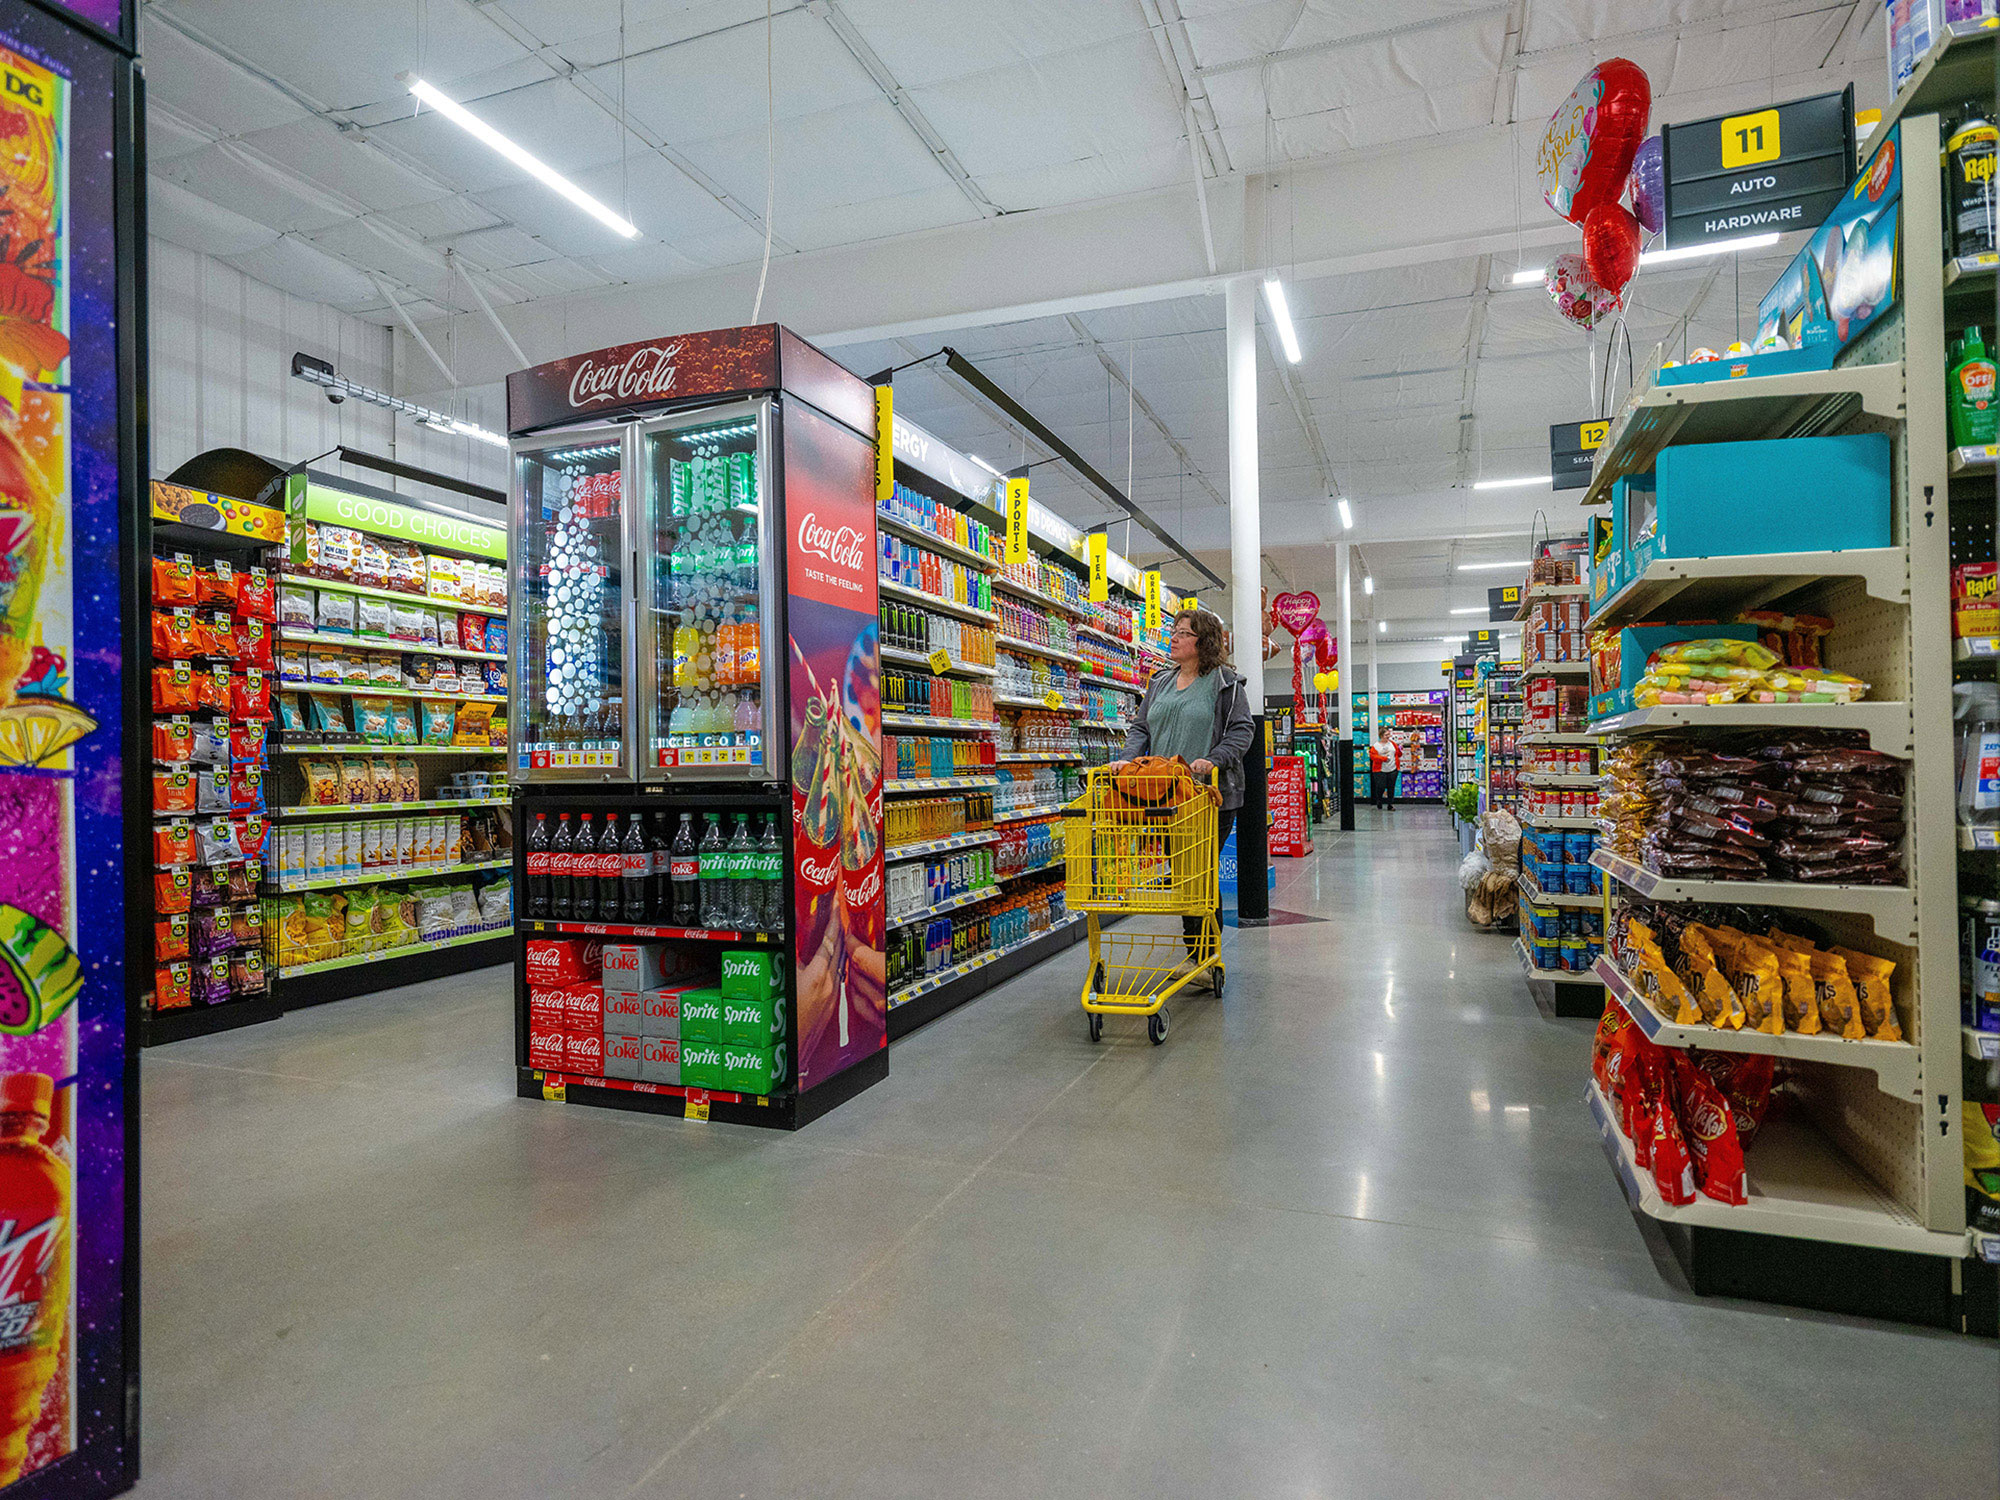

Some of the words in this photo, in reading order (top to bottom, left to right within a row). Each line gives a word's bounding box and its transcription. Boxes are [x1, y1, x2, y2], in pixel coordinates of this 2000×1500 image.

[4, 69, 43, 107] DG
[1734, 125, 1764, 154] 11
[1730, 176, 1776, 195] AUTO
[1704, 206, 1802, 234] HARDWARE
[569, 343, 683, 407] Coca-Cola
[1965, 374, 1993, 386] OFF!
[893, 425, 930, 463] ERGY
[1585, 429, 1604, 443] 12
[1573, 455, 1594, 465] SEAS
[337, 498, 404, 530] GOOD
[410, 516, 492, 549] CHOICES
[1013, 488, 1021, 553] SPORTS
[798, 512, 866, 571] Coca-Cola
[805, 568, 824, 583] TASTE
[825, 574, 838, 587] THE
[838, 578, 864, 593] FEELING
[1966, 575, 1997, 597] Raid
[1284, 597, 1312, 608] Happy
[1505, 591, 1515, 599] 14
[1288, 613, 1307, 625] Day
[568, 741, 620, 751] COLD
[704, 735, 760, 748] COLD
[622, 856, 646, 870] oke
[759, 855, 783, 871] rite
[584, 924, 606, 934] Coca-Cola
[633, 926, 657, 937] Coca-Cola
[684, 929, 709, 939] Coca-Cola
[603, 952, 639, 971] Coke
[723, 959, 761, 979] Sprite
[605, 995, 640, 1015] Coke
[643, 999, 680, 1019] Coke
[683, 1002, 720, 1021] Sprite
[724, 1005, 762, 1025] Sprite
[605, 1039, 640, 1059] Coke
[643, 1043, 680, 1064] Coke
[683, 1047, 721, 1066] Sprite
[724, 1051, 763, 1071] Sprite
[584, 1076, 606, 1088] Coca-Cola
[632, 1082, 657, 1093] Coca-Cola
[696, 1109, 708, 1119] FREE
[0, 1301, 39, 1322] ODE
